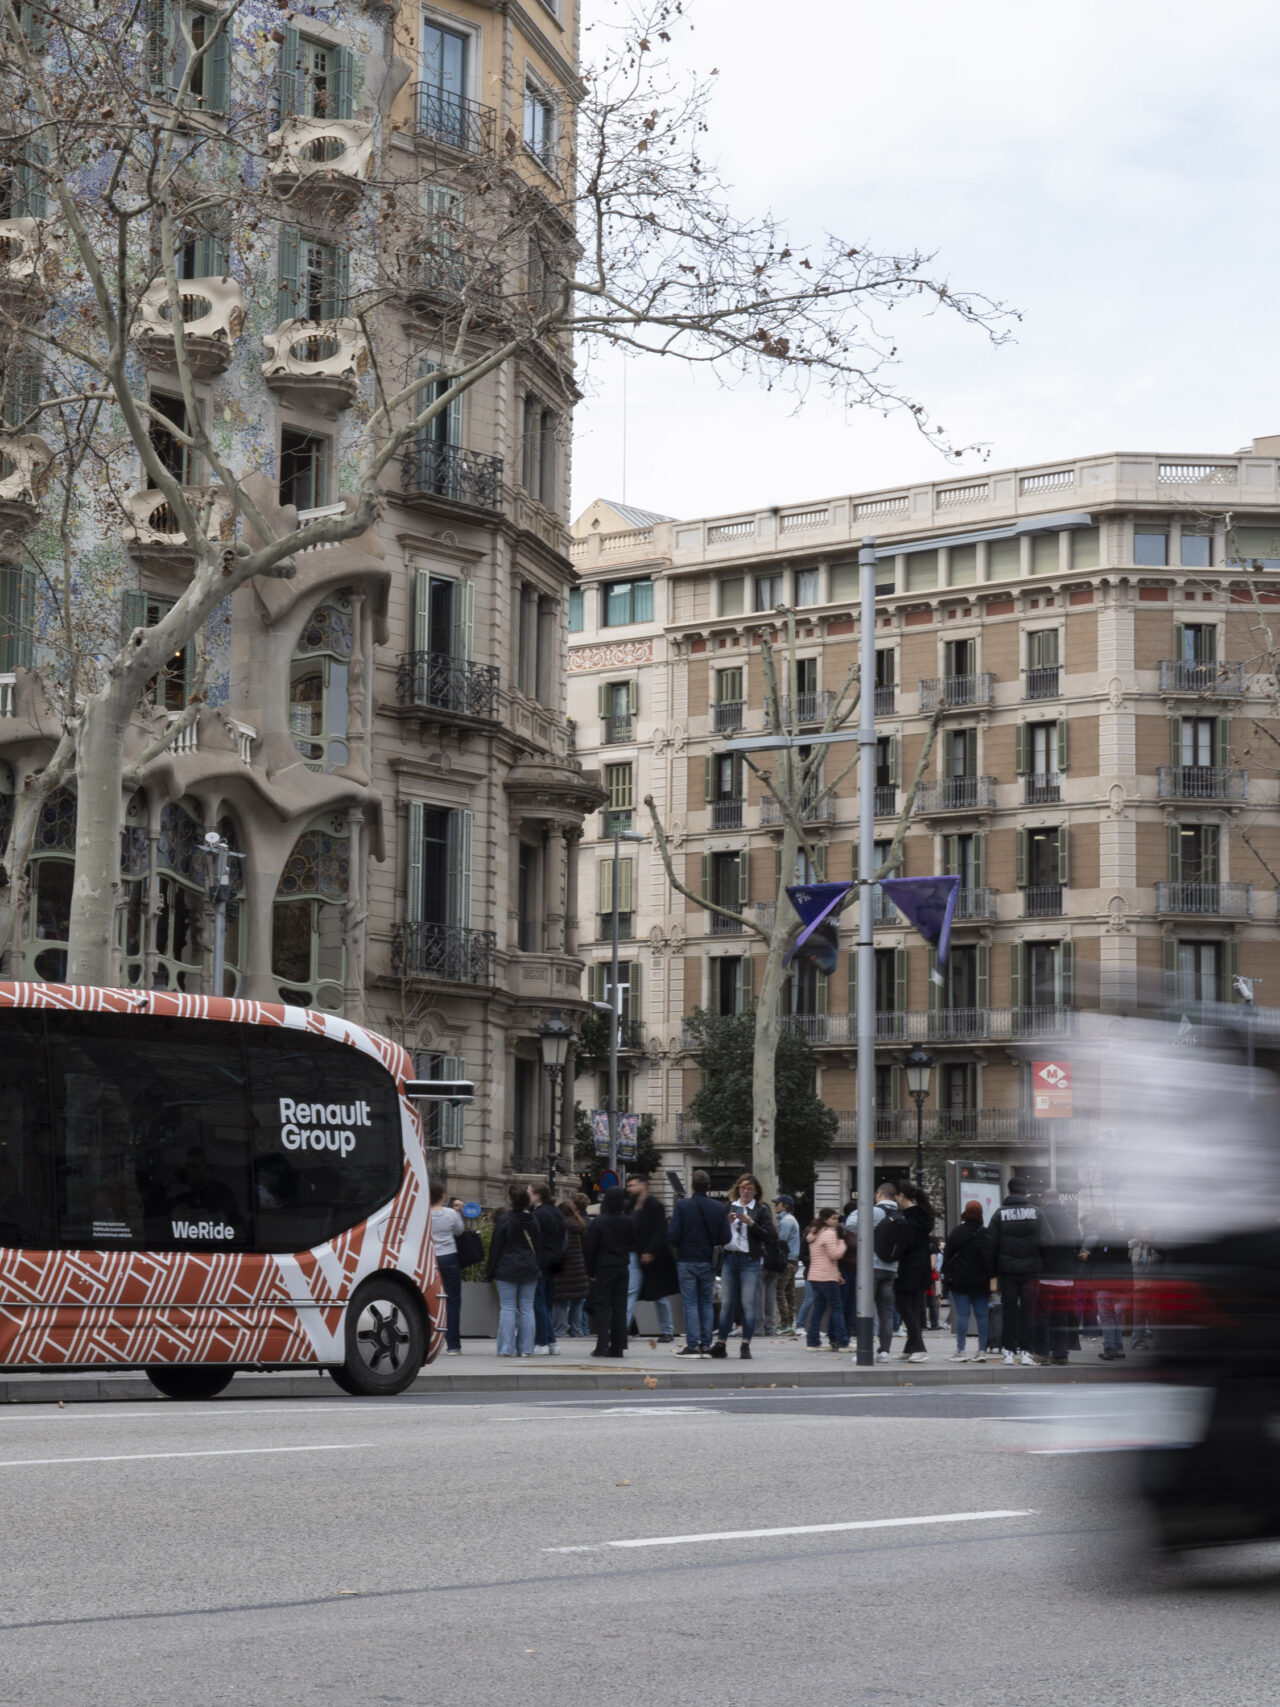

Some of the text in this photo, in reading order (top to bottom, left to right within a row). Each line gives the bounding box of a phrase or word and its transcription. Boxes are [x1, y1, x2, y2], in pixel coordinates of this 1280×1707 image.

[1047, 1069, 1058, 1079] M
[279, 1097, 372, 1126] Renault
[281, 1123, 356, 1158] Group
[171, 1220, 235, 1240] WeRide
